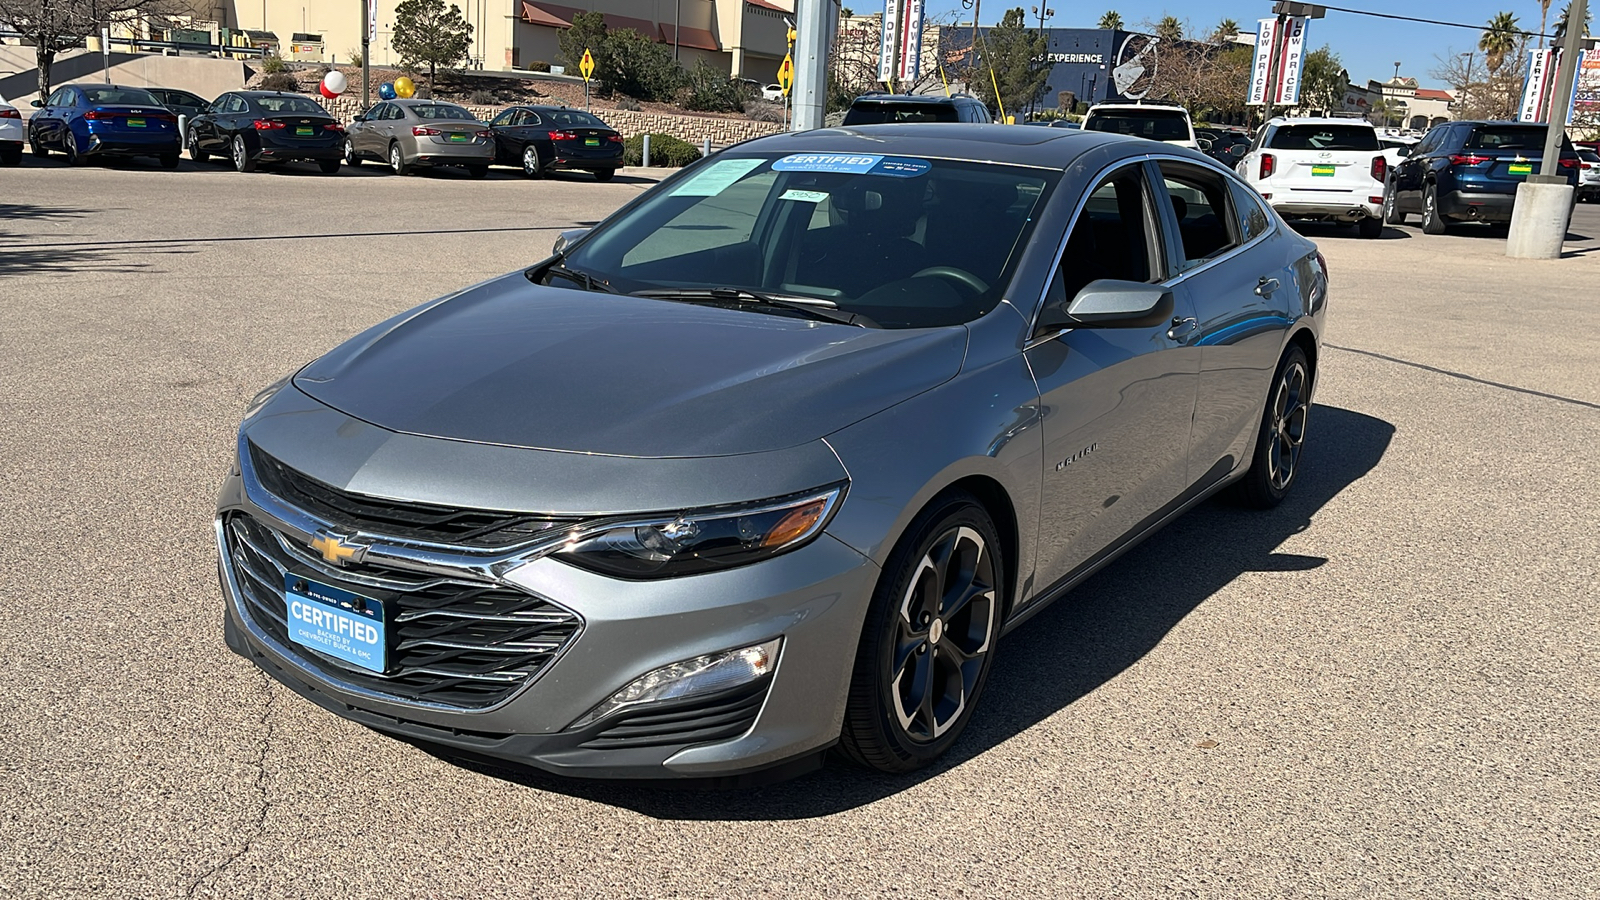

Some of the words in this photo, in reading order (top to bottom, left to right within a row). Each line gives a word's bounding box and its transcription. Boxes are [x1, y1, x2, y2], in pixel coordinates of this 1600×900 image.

[884, 22, 894, 75] OWNED
[907, 21, 918, 74] OWNED
[1261, 23, 1270, 46] LOW
[1292, 21, 1302, 45] LOW
[1047, 53, 1103, 63] EXPERIENCE
[1253, 54, 1267, 101] PRICES
[1284, 53, 1298, 101] PRICES
[1525, 53, 1542, 120] CERTIFIED
[782, 155, 873, 165] CERTIFIED
[1056, 442, 1098, 472] MALIBU
[291, 601, 379, 645] CERTIFIED
[317, 629, 341, 642] BACKED
[342, 637, 351, 645] BY
[298, 629, 332, 646] CHEVROLET
[333, 641, 351, 652] BUICK
[352, 647, 357, 655] &
[358, 650, 371, 660] GMC
